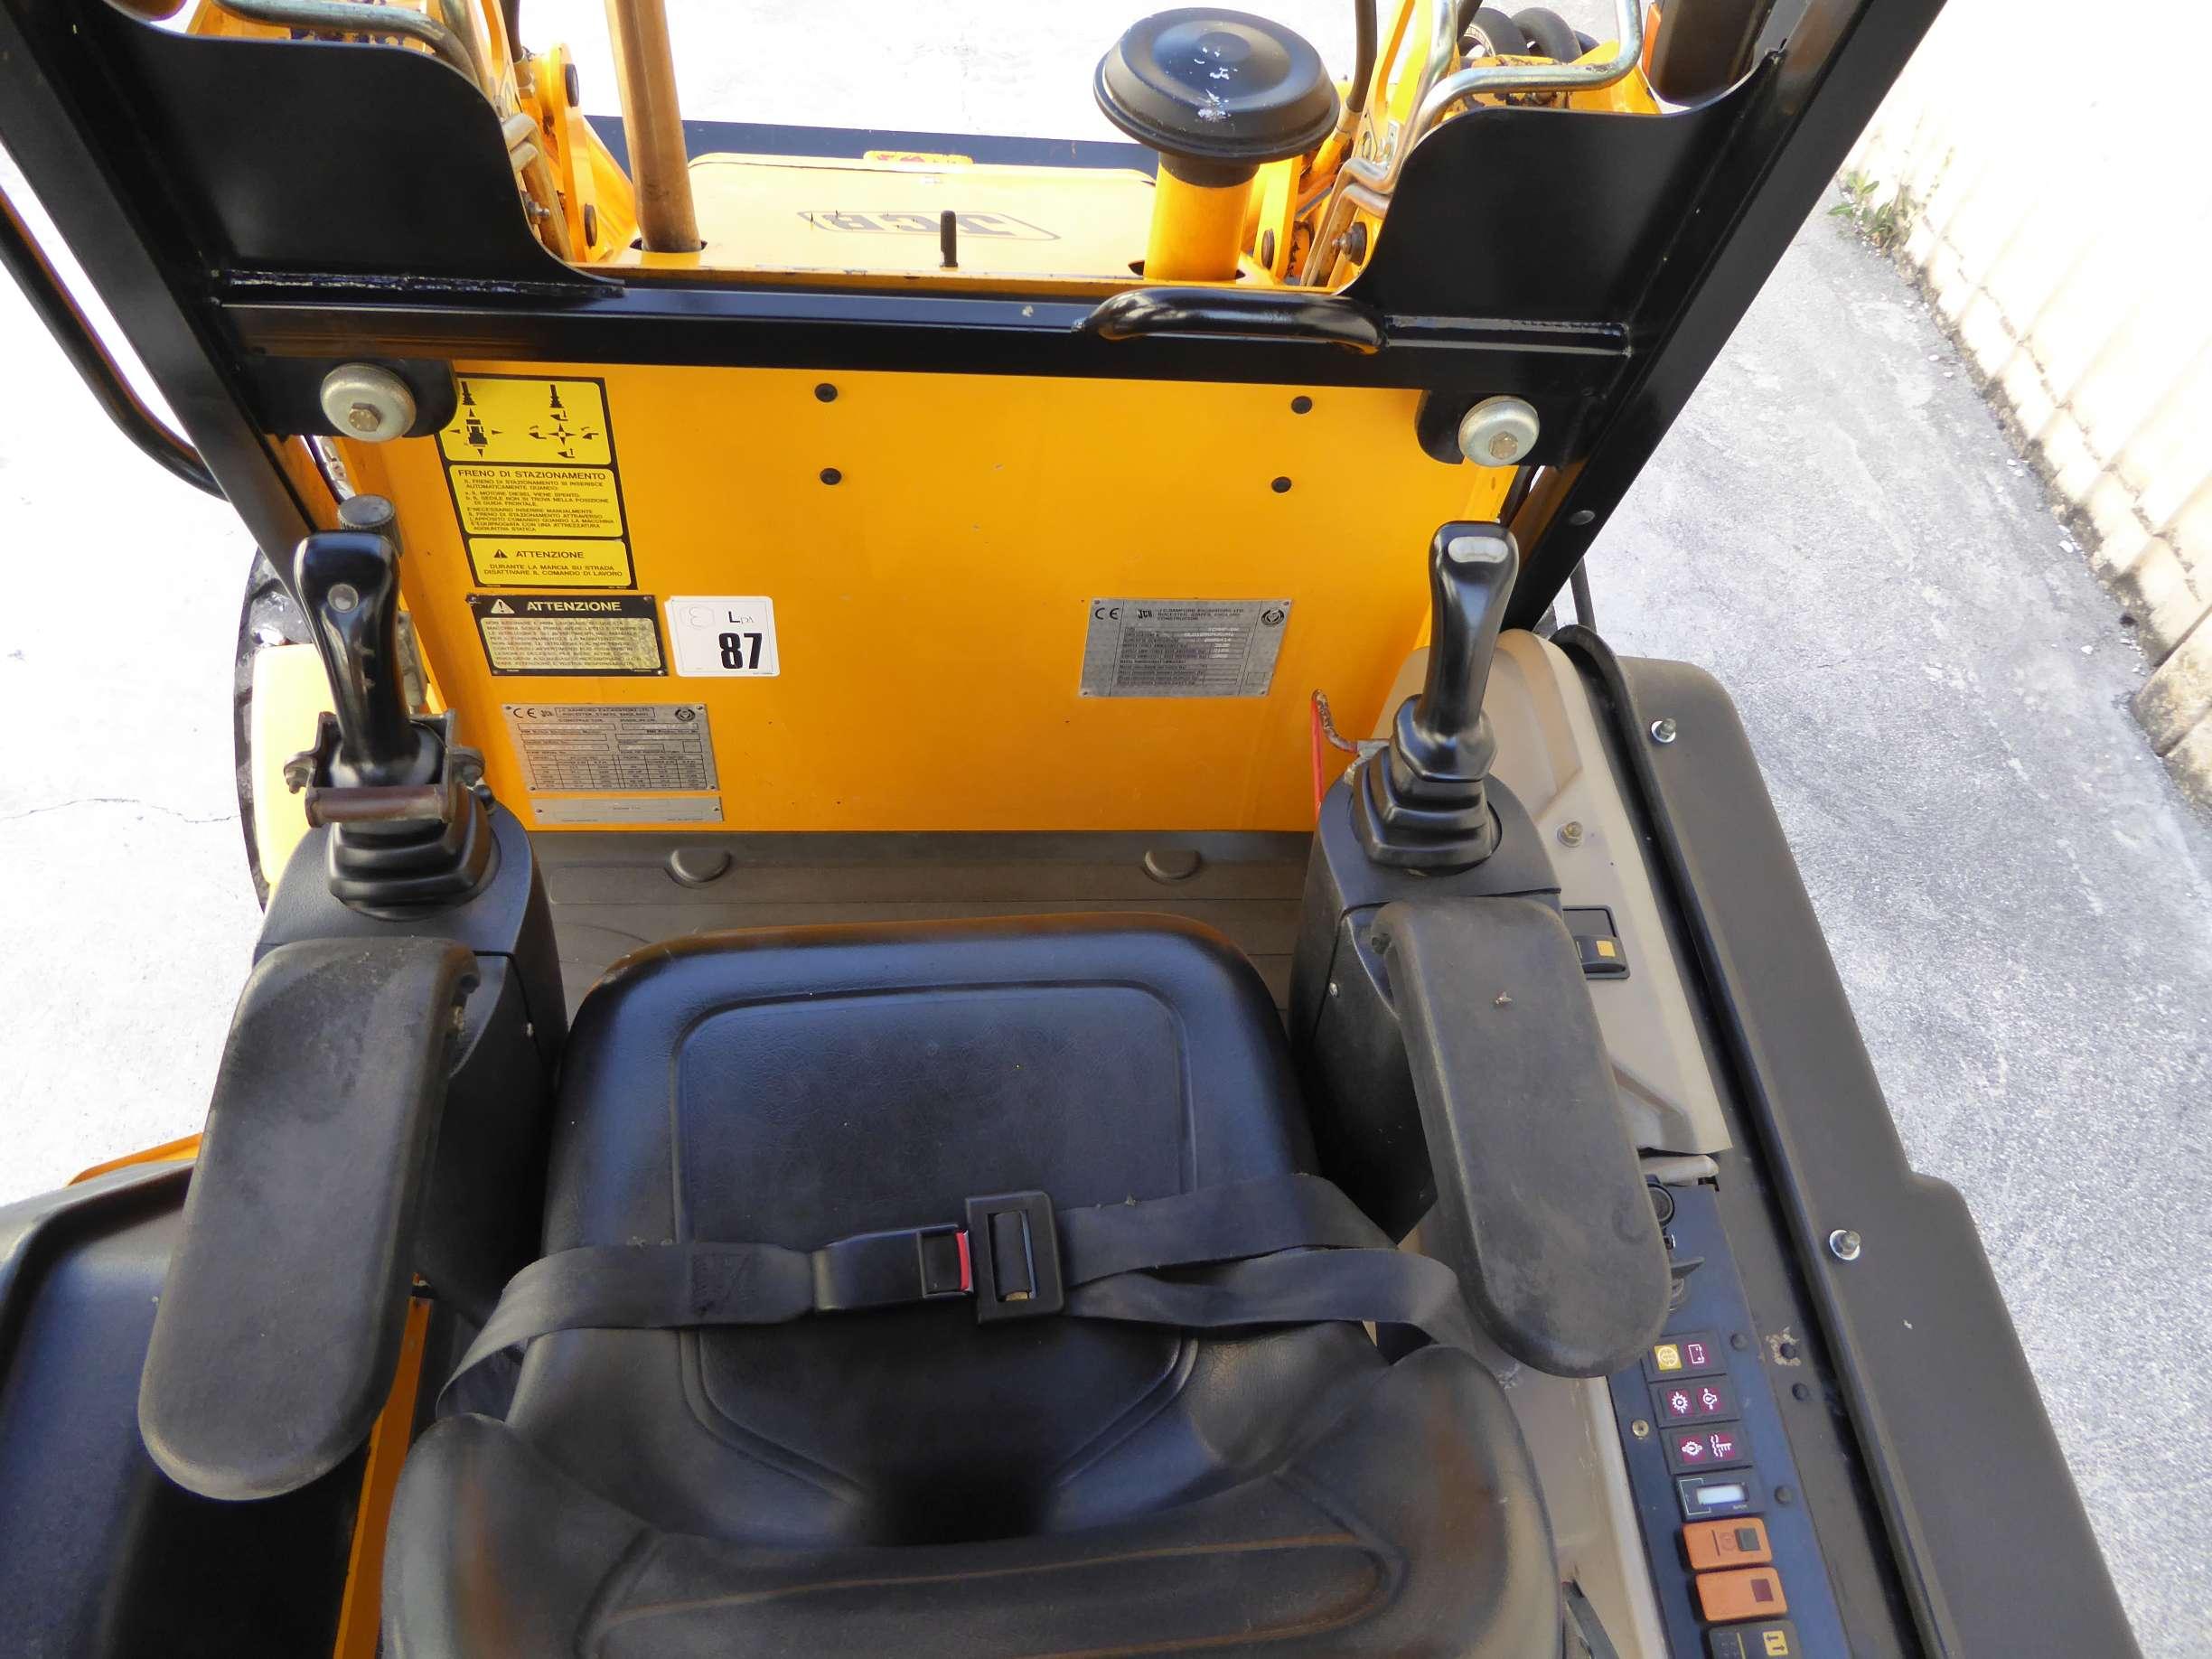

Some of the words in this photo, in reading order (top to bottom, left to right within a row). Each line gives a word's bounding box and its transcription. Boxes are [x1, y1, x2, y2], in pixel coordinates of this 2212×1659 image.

[820, 213, 1017, 236] JCB
[515, 471, 606, 480] STAZIONAMENTO
[515, 550, 585, 558] ATTENZIONE
[527, 602, 622, 611] ATTENZIONE
[1094, 607, 1120, 620] CE
[718, 633, 763, 669] 87
